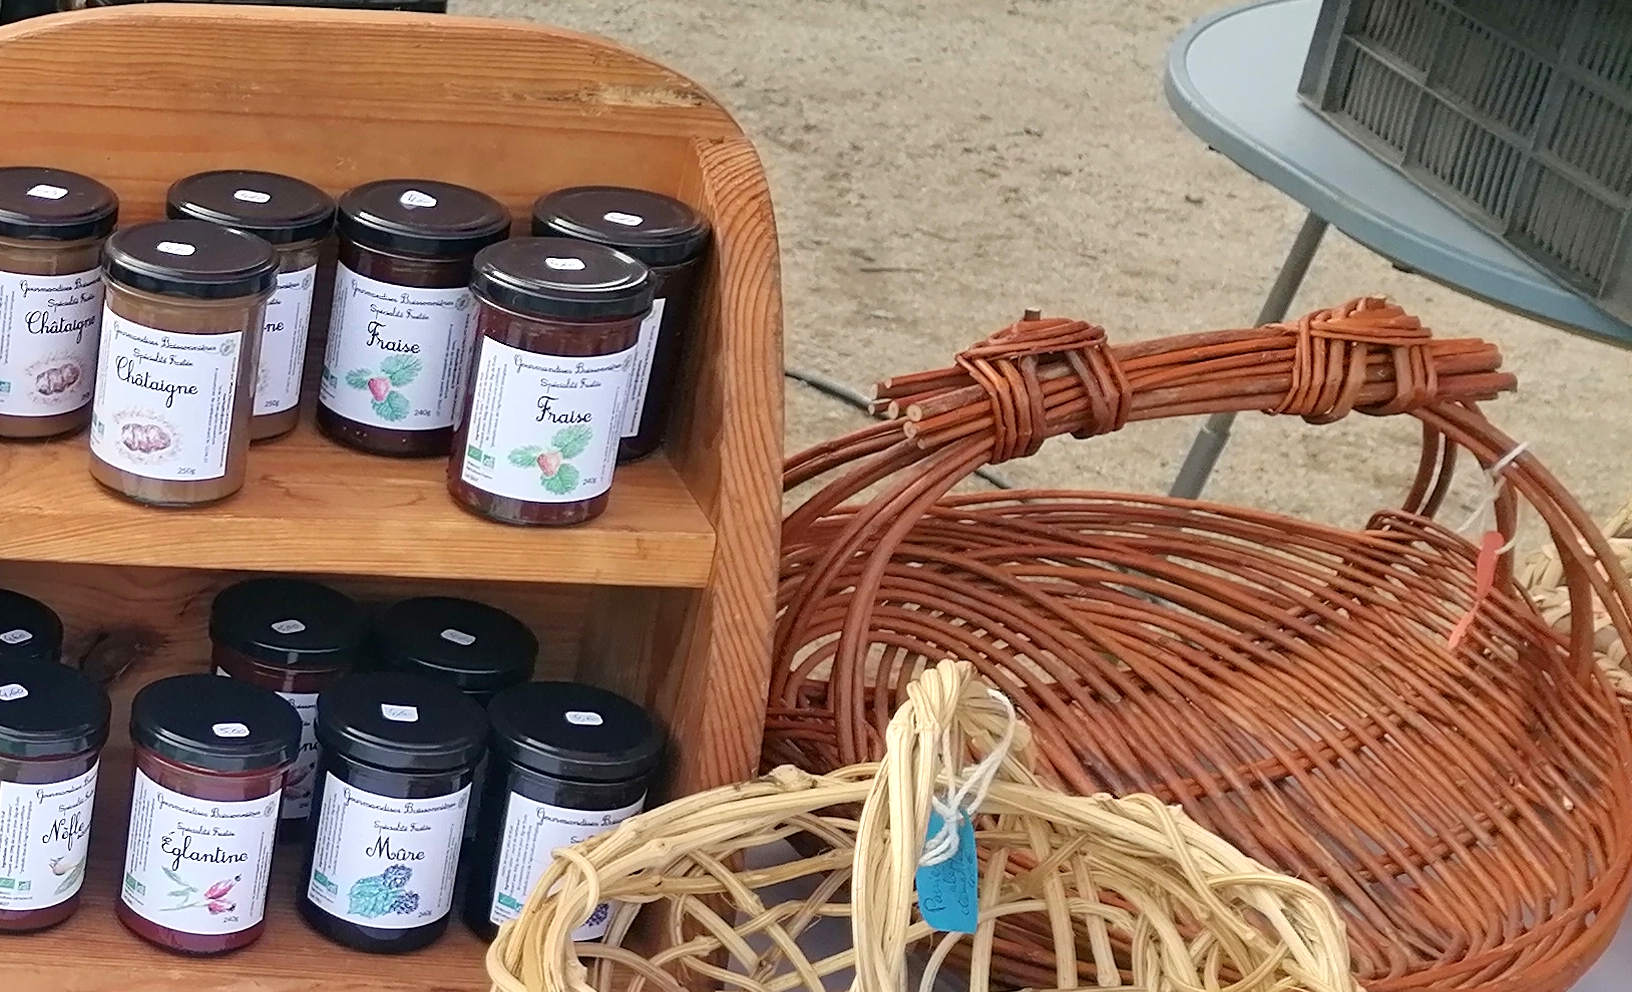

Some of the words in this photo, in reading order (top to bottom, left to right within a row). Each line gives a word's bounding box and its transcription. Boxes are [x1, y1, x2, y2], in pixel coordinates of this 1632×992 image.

[366, 320, 421, 354] Fraise
[116, 355, 199, 409] Châtaigne
[536, 395, 592, 424] Fraise
[161, 831, 248, 871] Églantine
[365, 835, 426, 861] Mûre
